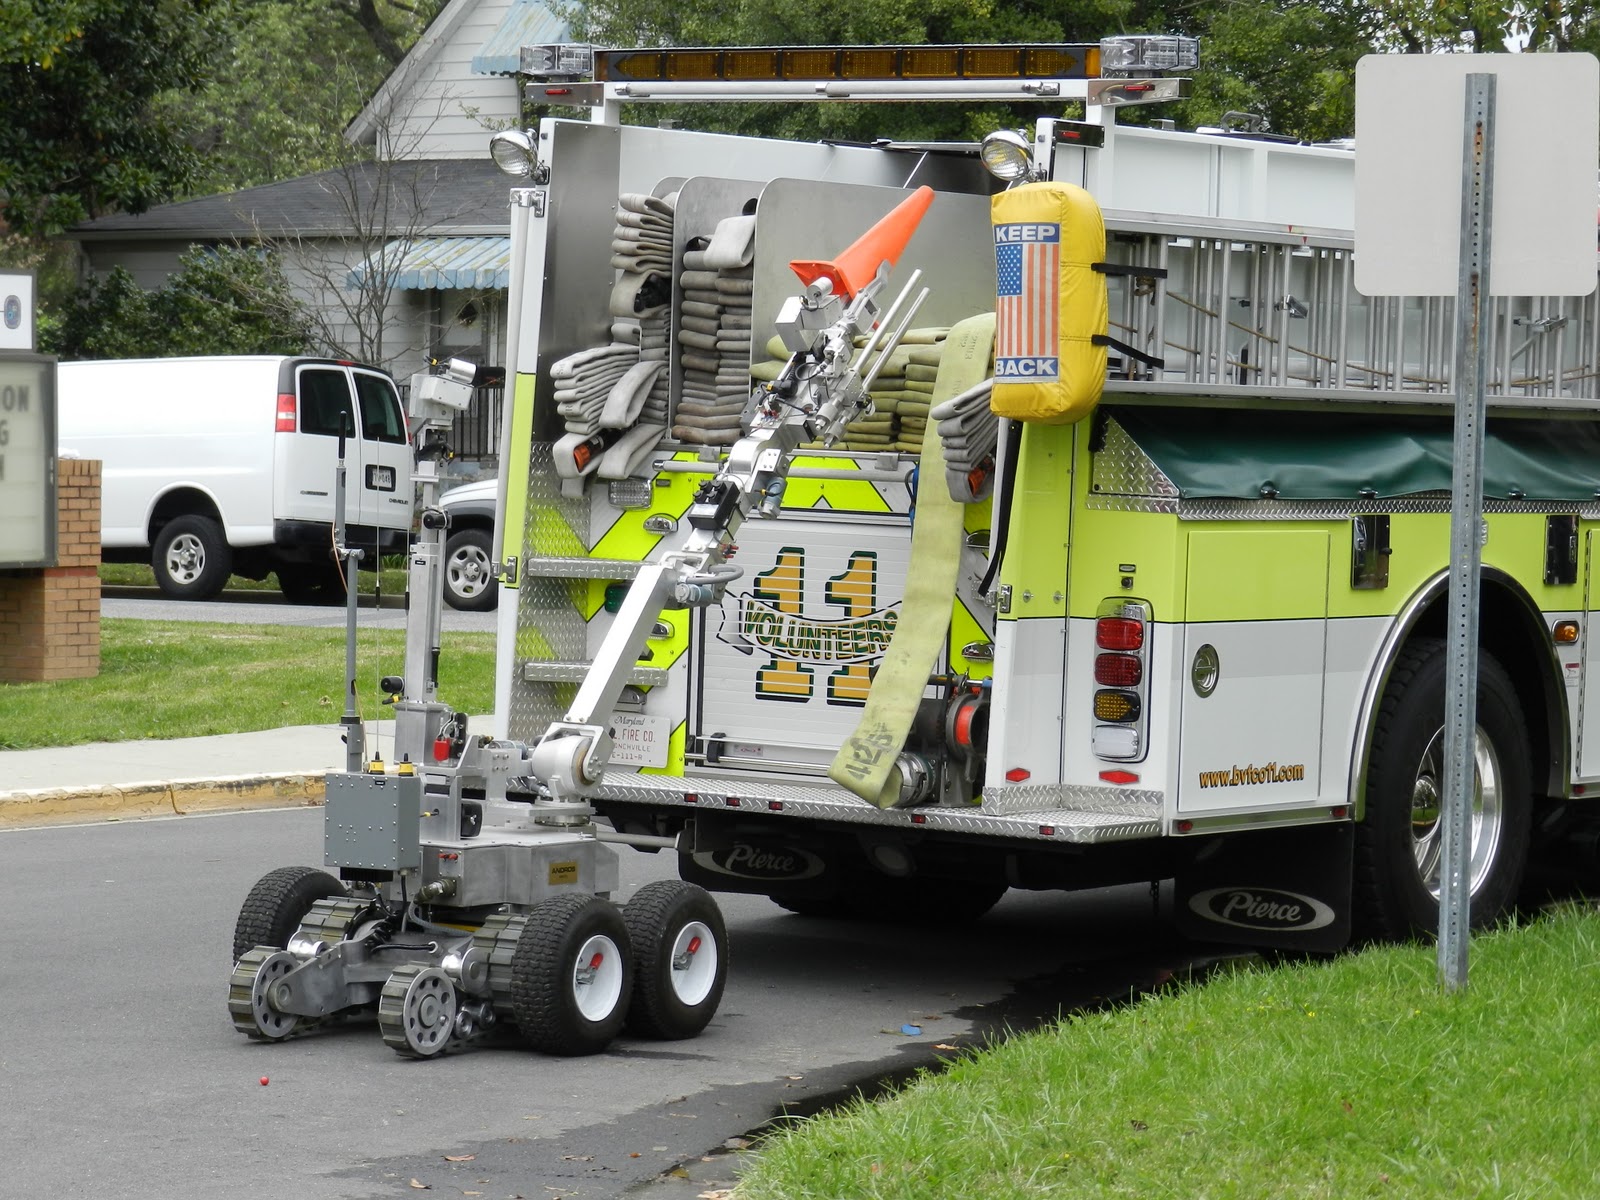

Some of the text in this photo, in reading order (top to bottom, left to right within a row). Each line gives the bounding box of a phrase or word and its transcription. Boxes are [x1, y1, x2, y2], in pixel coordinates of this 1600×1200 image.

[996, 225, 1056, 242] KEEP
[995, 359, 1056, 376] BACK
[2, 385, 29, 412] ON
[744, 599, 898, 661] VOLUNTEERS
[754, 546, 877, 707] 11
[614, 715, 646, 727] Maryland
[622, 728, 640, 742] FIRE
[643, 730, 656, 743] CO.
[1199, 761, 1305, 789] www.bvfco11.com
[724, 842, 796, 872] Pierce
[1222, 891, 1302, 922] Pierce
